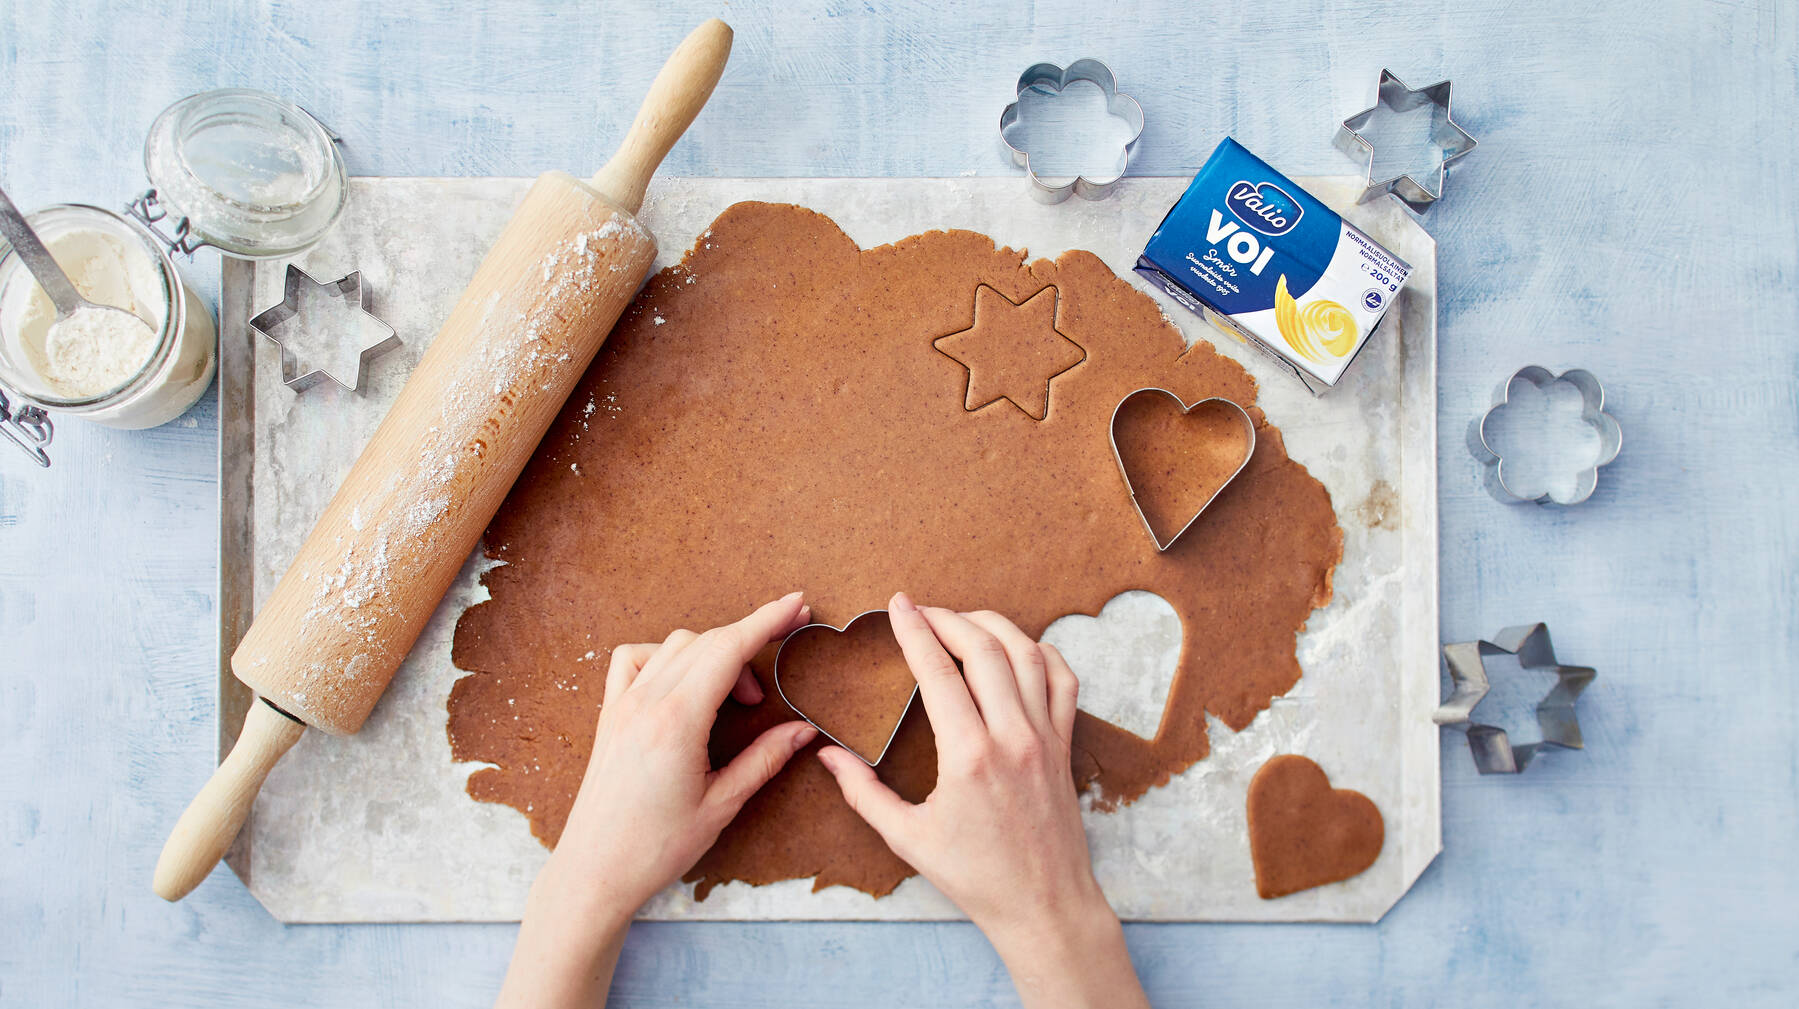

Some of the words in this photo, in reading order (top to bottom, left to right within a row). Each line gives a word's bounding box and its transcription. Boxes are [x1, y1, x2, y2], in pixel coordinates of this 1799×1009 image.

[1234, 187, 1287, 228] Valio
[1206, 208, 1275, 277] VOI
[1345, 231, 1409, 277] NORMAALISUOLAINEN
[1203, 249, 1237, 277] Smör
[1359, 249, 1405, 283] NORMALSALTAT
[1369, 268, 1390, 285] 200
[1388, 283, 1398, 292] g
